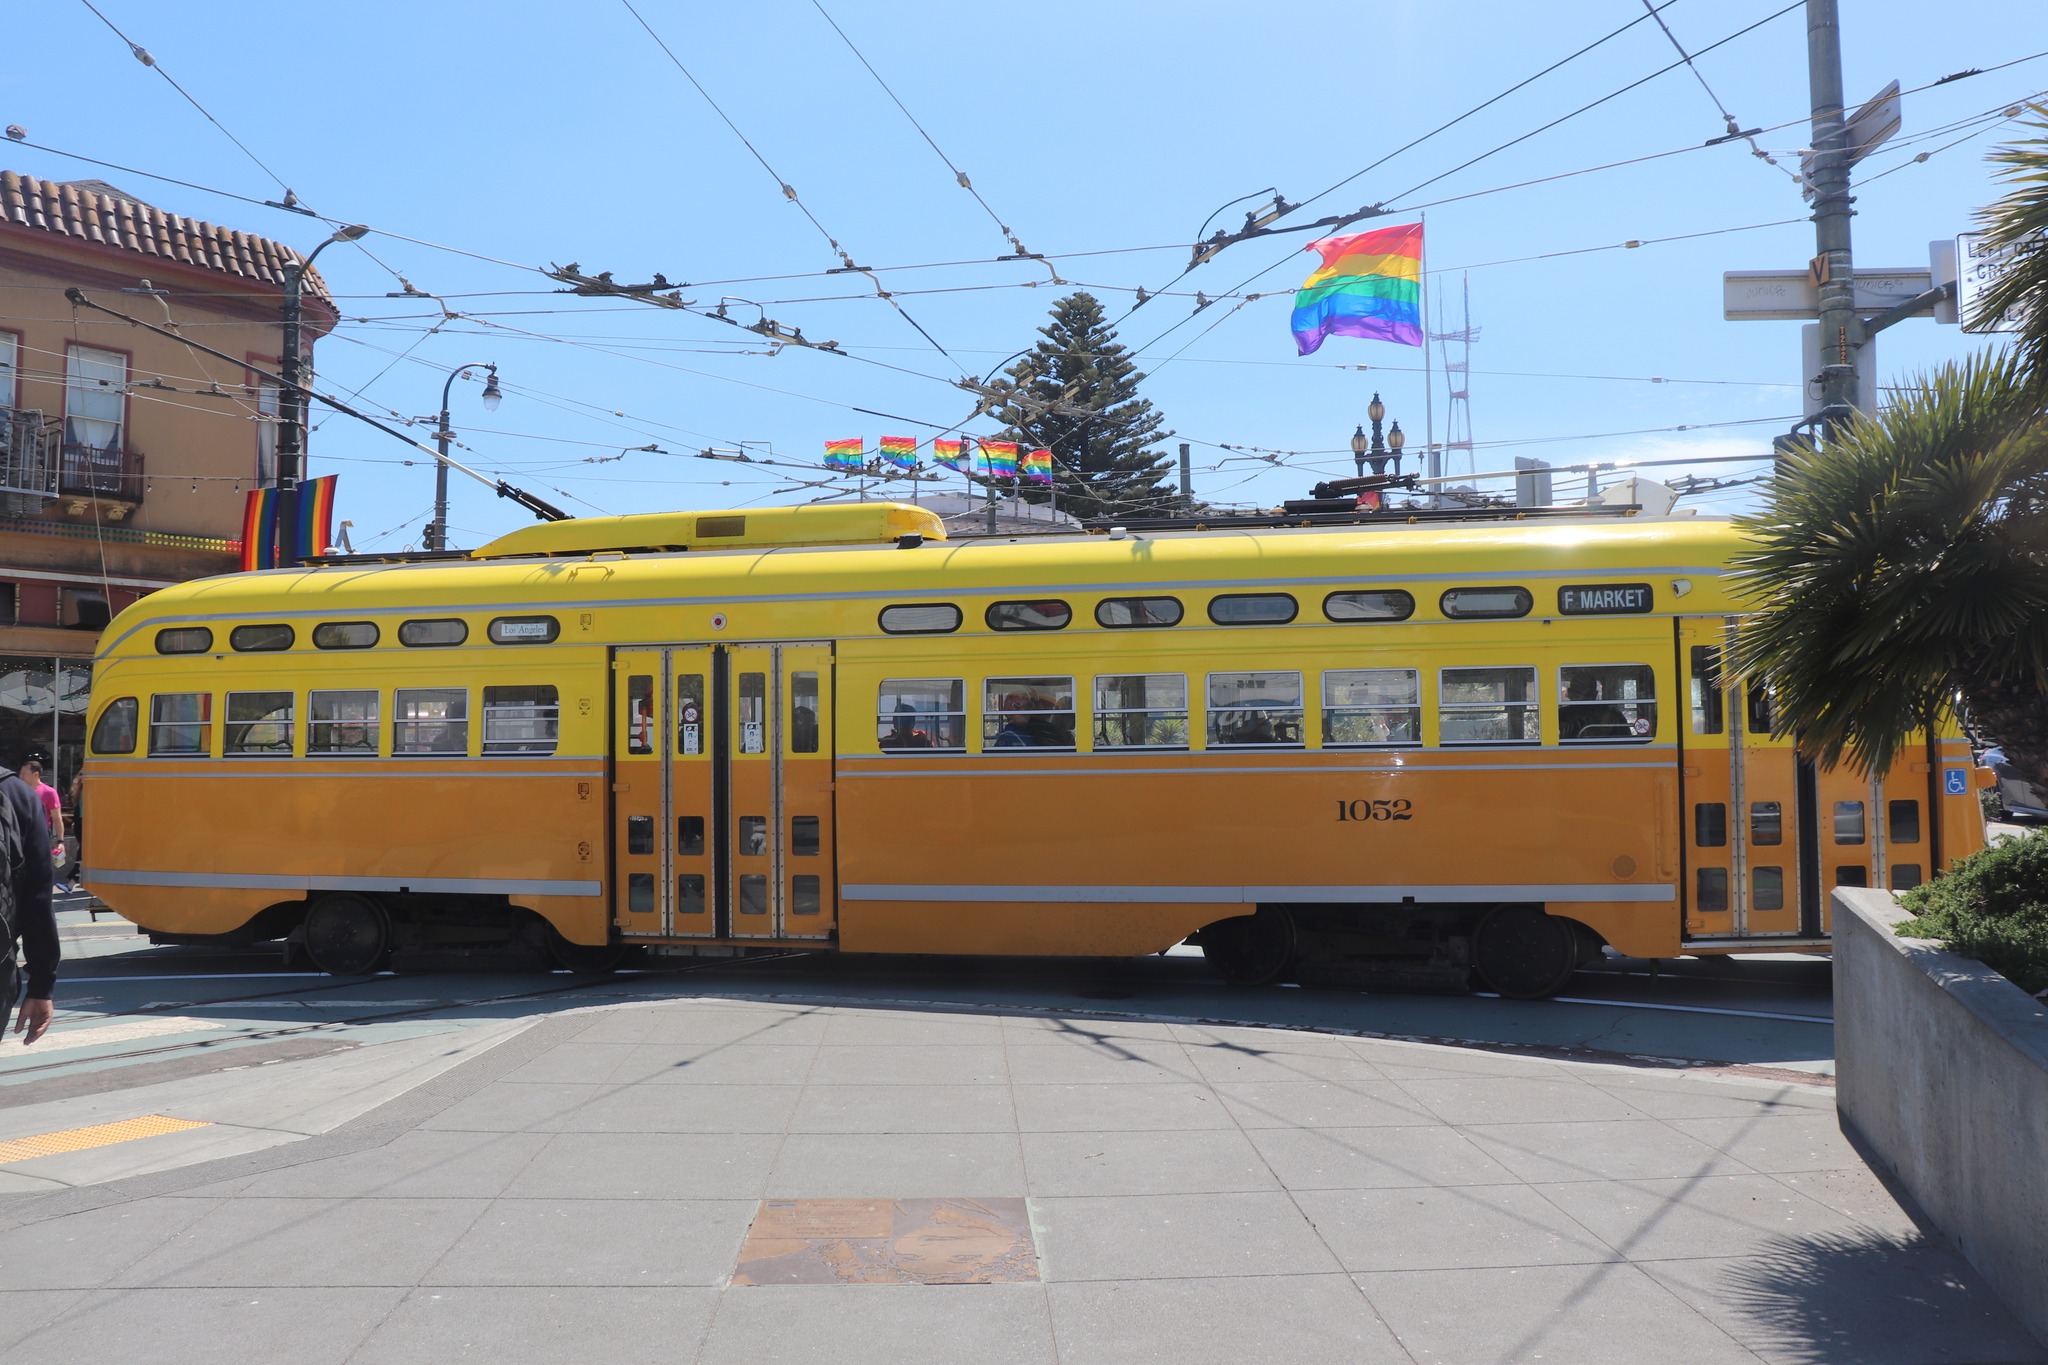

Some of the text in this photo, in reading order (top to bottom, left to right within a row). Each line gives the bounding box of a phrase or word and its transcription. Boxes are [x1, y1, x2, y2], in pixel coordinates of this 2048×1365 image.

[1812, 257, 1825, 285] V
[1564, 589, 1645, 610] F MARKET
[504, 624, 545, 635] Los Angeles
[1335, 799, 1413, 822] 1052
